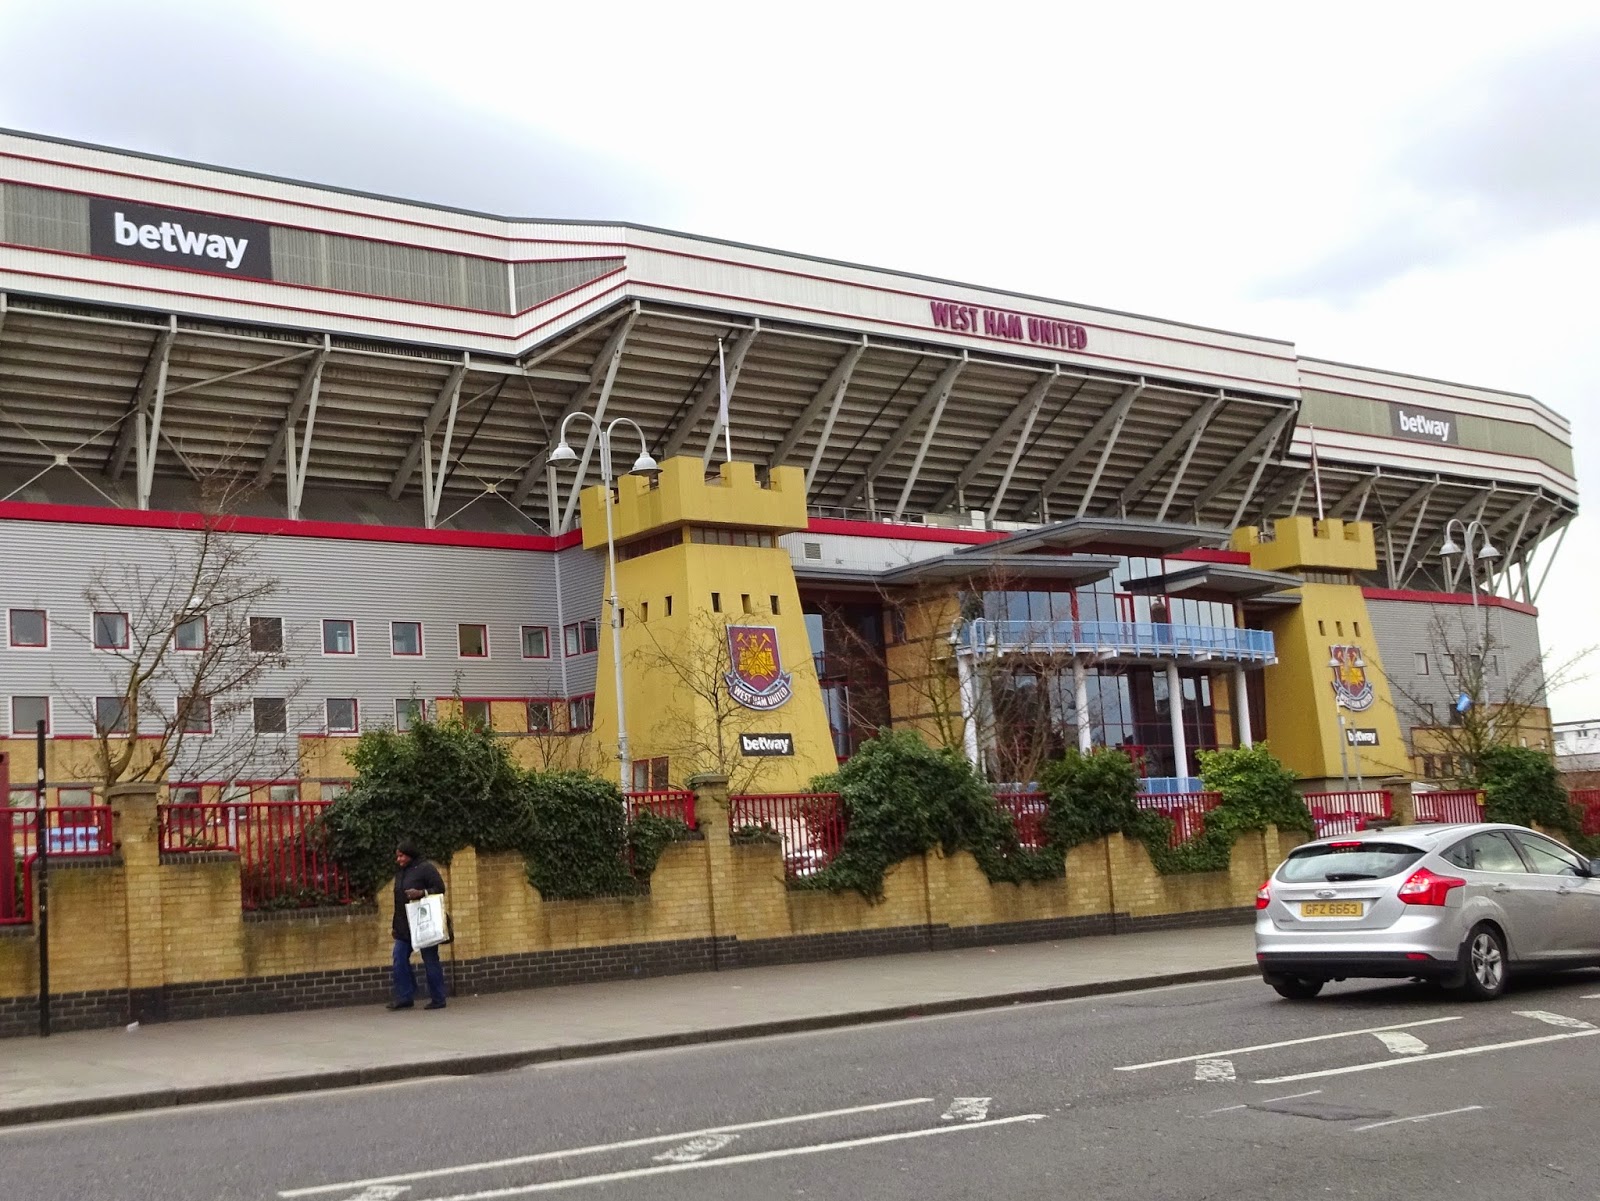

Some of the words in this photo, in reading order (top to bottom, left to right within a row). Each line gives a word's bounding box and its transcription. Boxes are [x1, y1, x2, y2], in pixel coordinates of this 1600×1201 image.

[114, 211, 249, 269] betway
[930, 301, 979, 333] WEST
[983, 310, 1024, 341] HAM
[1027, 317, 1088, 350] UNITED
[1398, 410, 1450, 442] betway
[733, 685, 752, 703] WEST
[767, 686, 788, 705] UNITED
[742, 735, 789, 754] betway
[1305, 904, 1326, 915] GFZ
